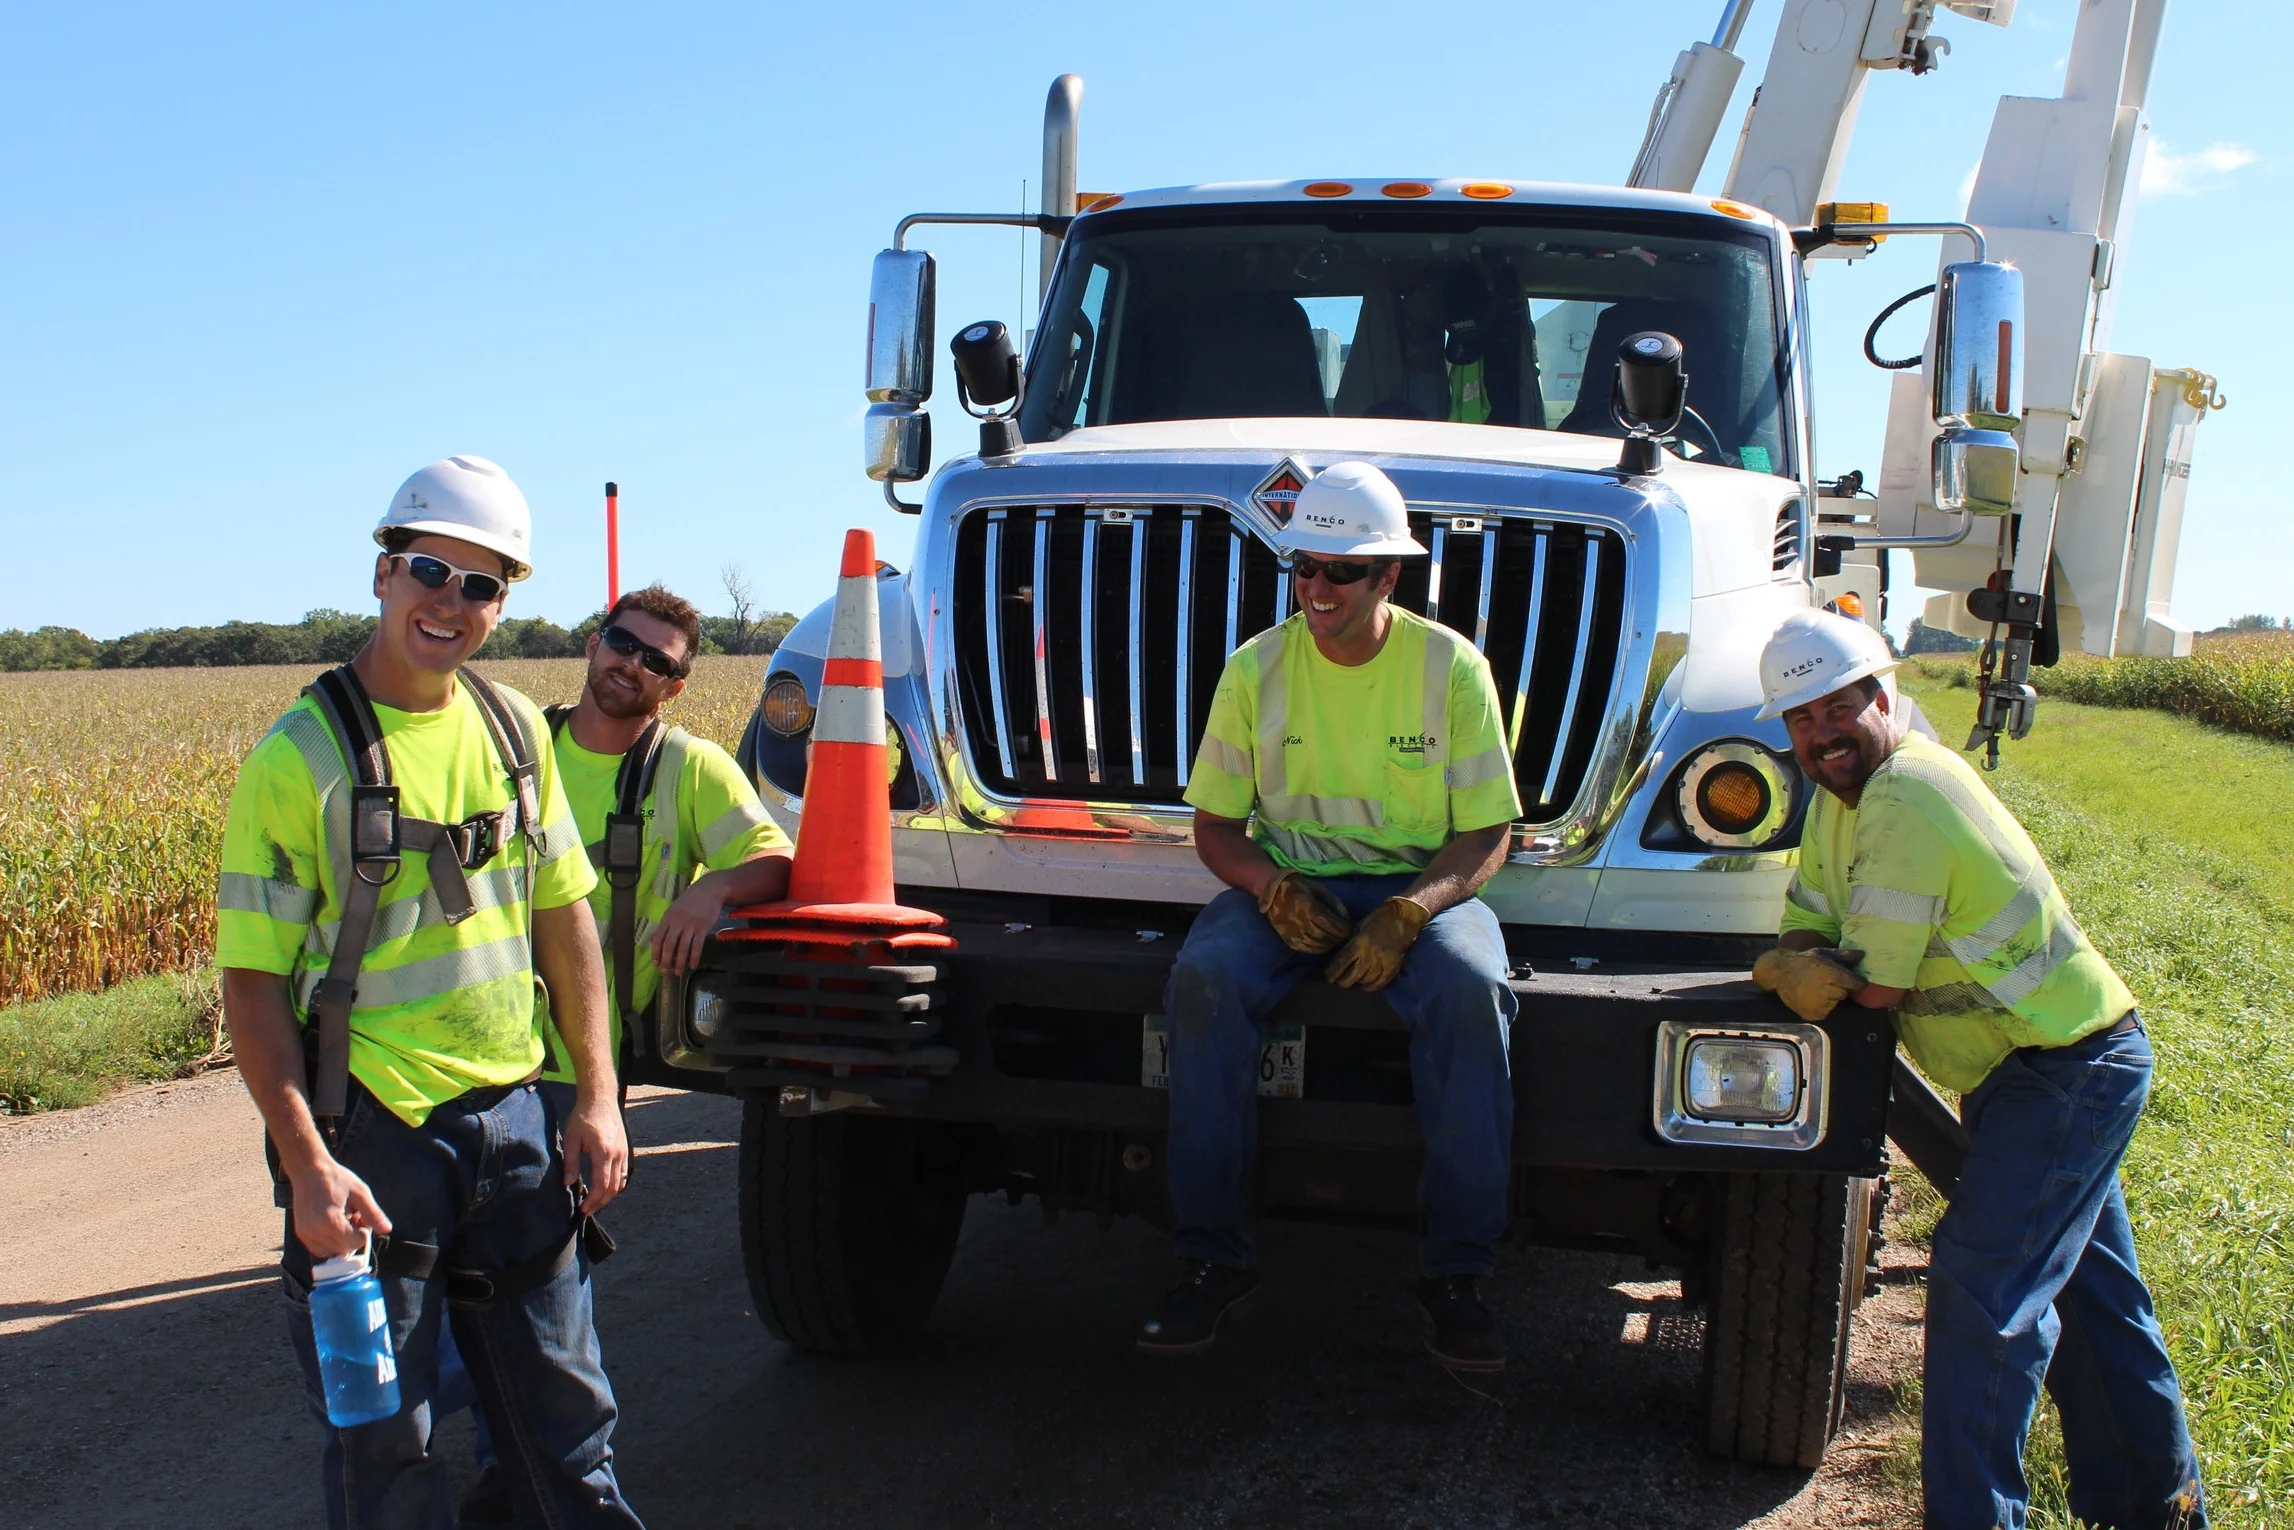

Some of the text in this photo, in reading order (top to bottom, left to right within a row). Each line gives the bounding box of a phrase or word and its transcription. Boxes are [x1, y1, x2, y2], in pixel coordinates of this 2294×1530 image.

[1262, 491, 1299, 499] INTERNATIO
[1306, 514, 1345, 525] BENCO
[1783, 657, 1823, 678] BENCO
[1282, 735, 1303, 747] Nick
[1389, 735, 1436, 744] BENCO
